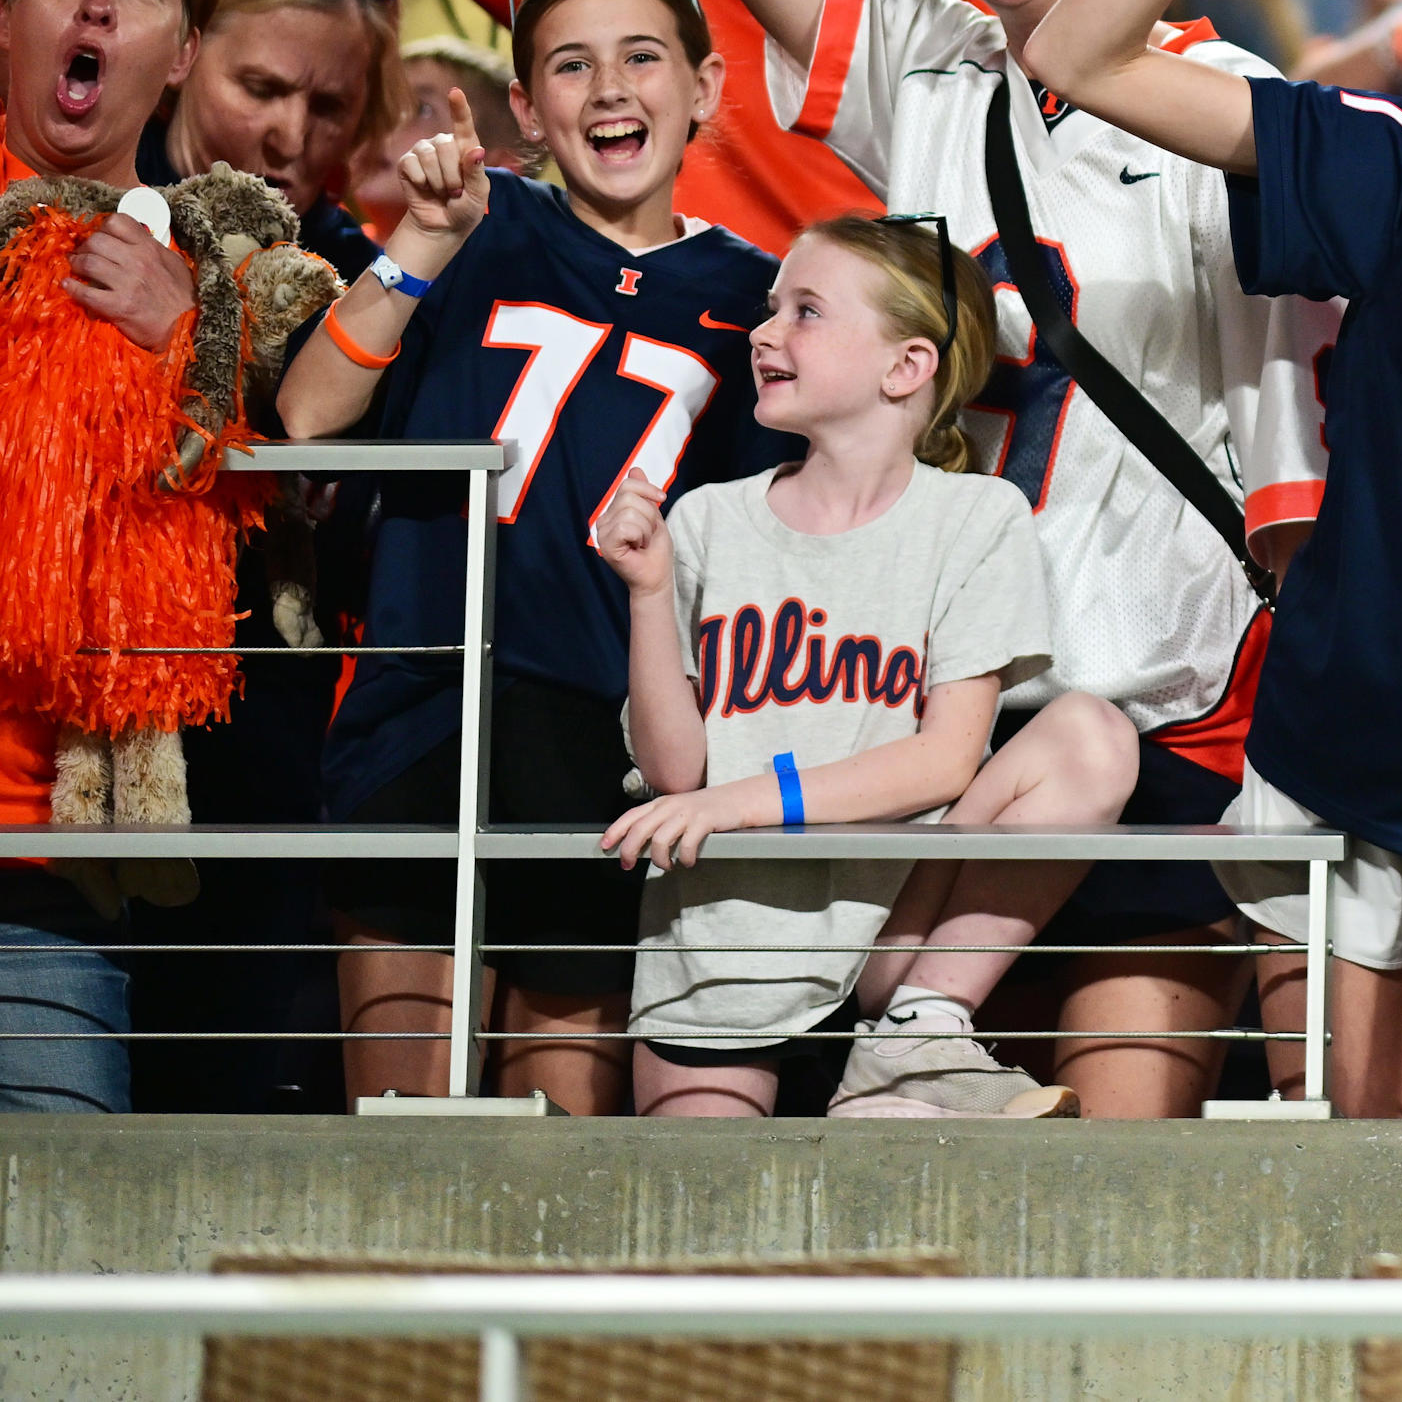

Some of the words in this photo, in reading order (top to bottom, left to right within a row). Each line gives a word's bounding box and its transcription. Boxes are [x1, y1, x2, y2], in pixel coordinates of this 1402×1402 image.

[615, 267, 643, 296] I
[461, 299, 722, 556] 77
[699, 597, 929, 719] Illino
